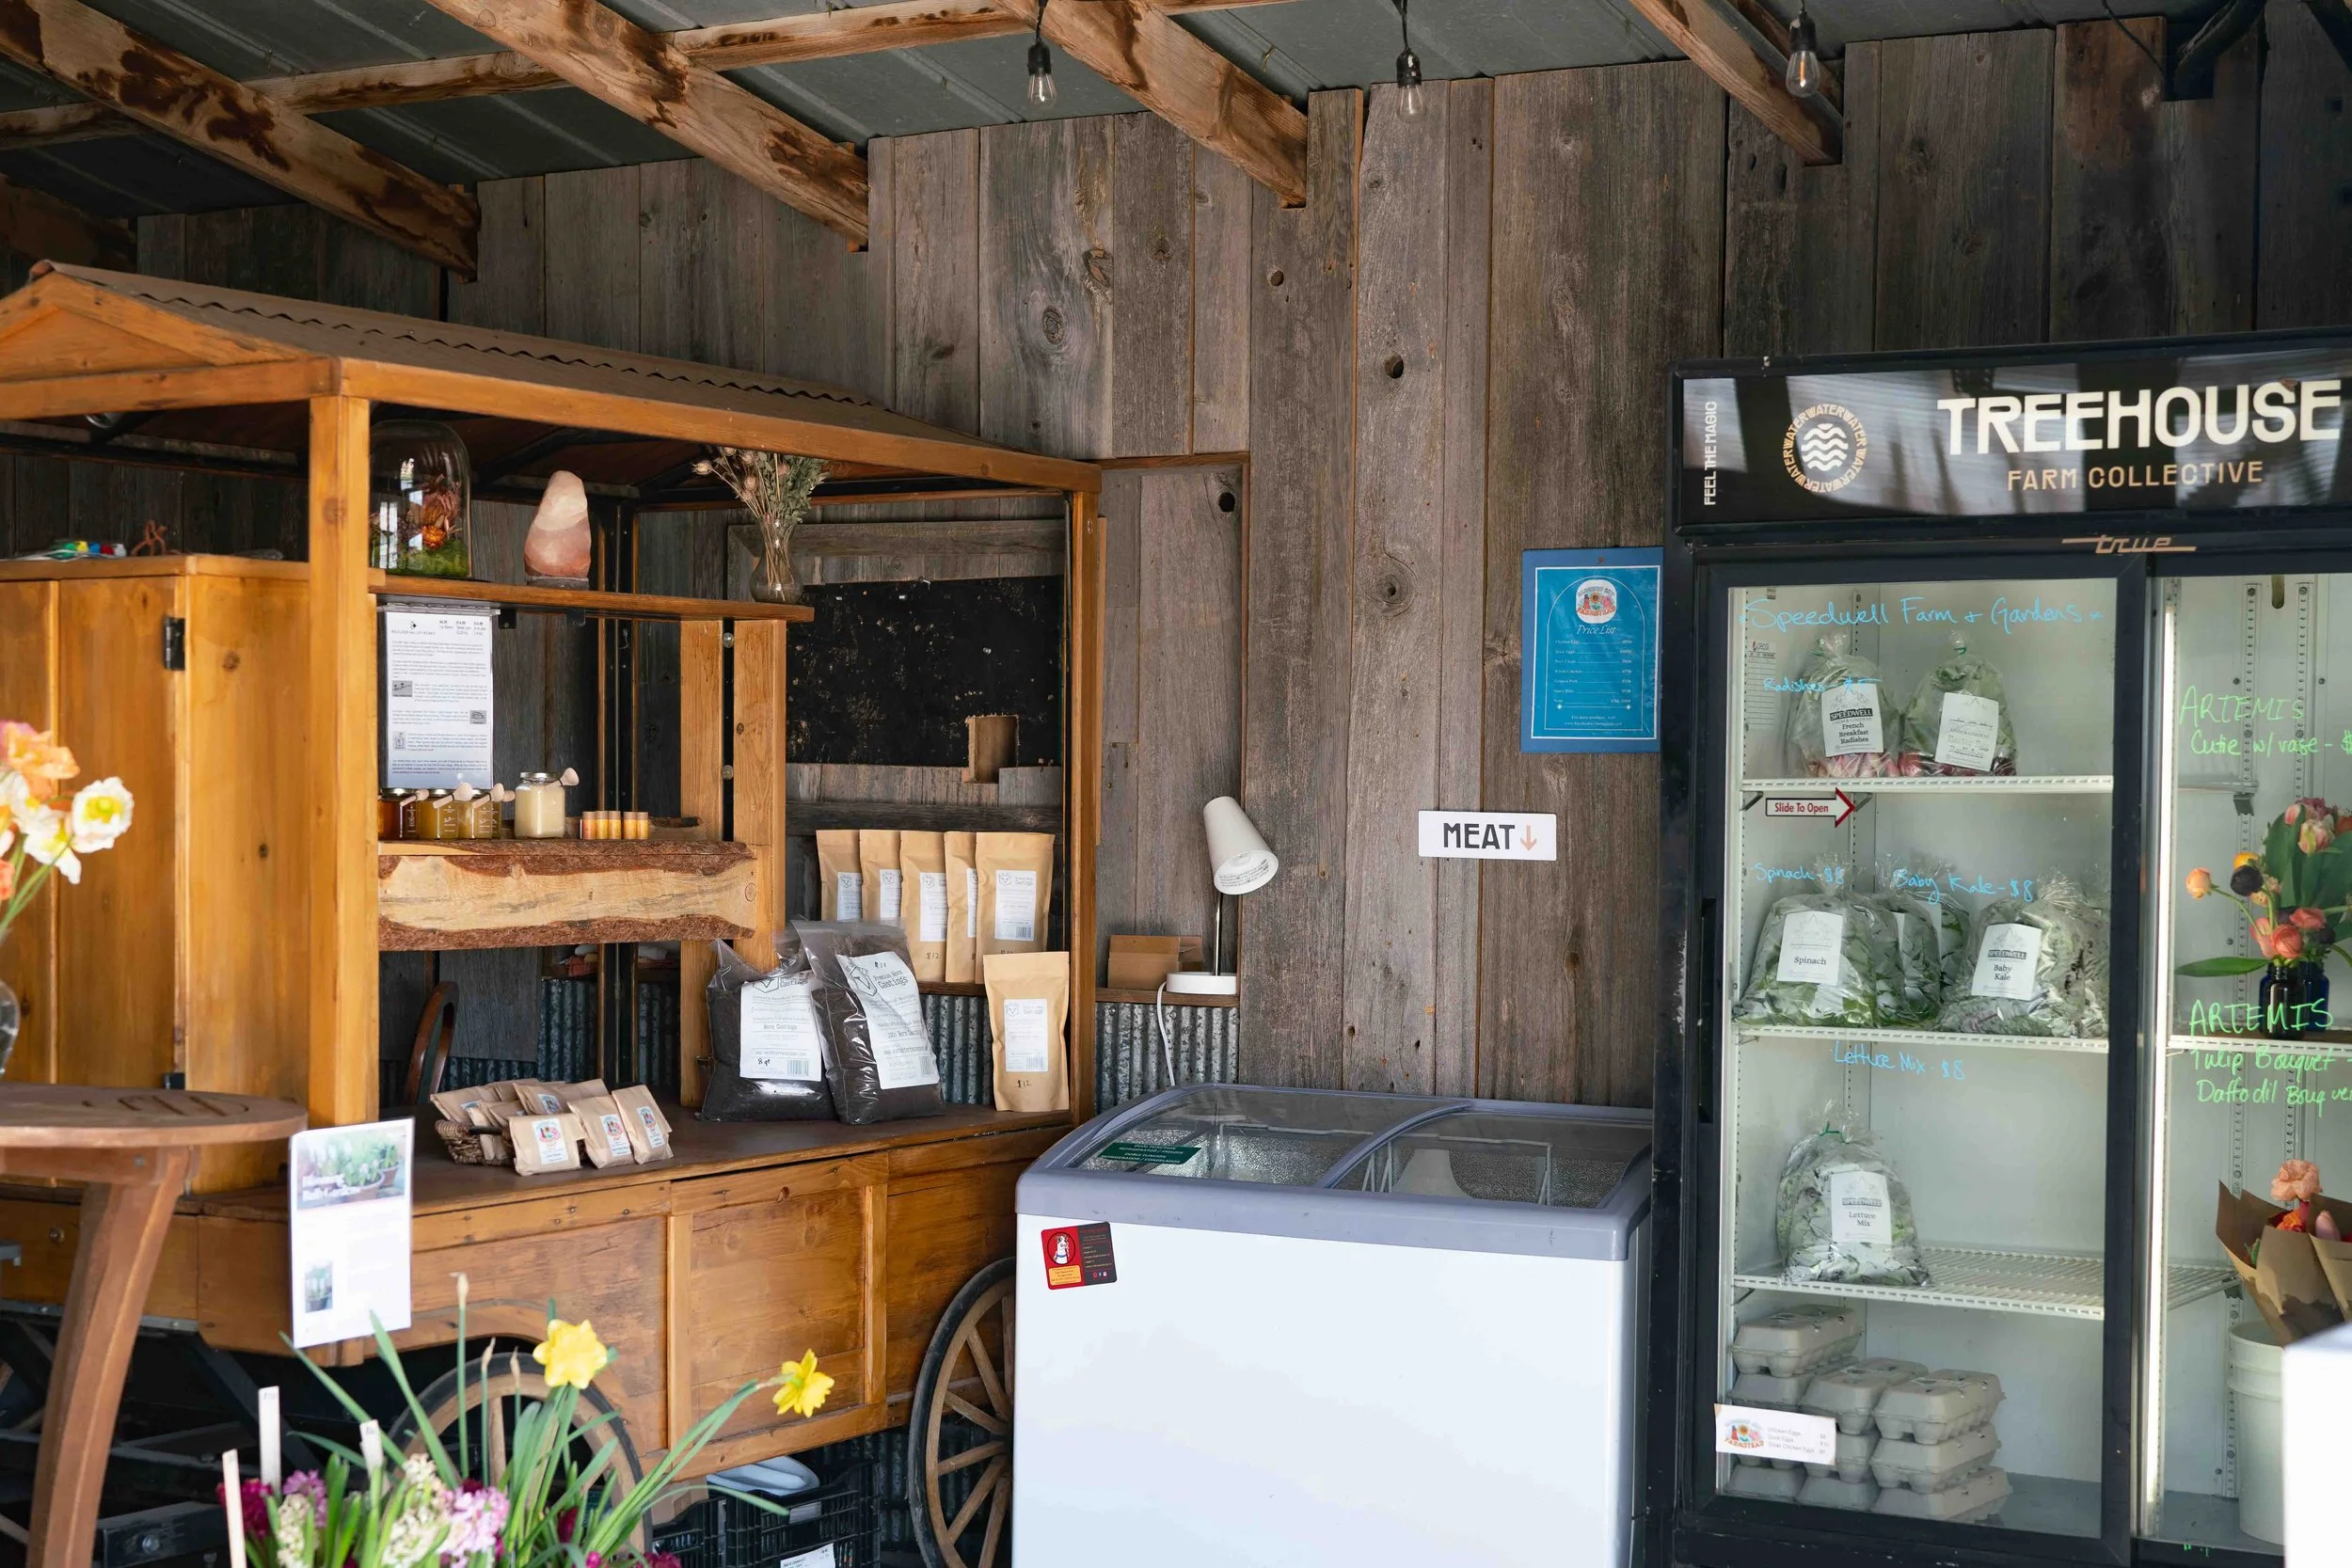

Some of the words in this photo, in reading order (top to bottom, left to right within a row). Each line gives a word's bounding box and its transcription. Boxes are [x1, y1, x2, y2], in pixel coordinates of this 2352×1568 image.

[1936, 379, 2342, 455] TREEHOUSE
[1704, 442, 1717, 470] THE
[1704, 471, 1716, 505] FEEL
[2008, 467, 2076, 491] FARM
[2088, 461, 2263, 488] COLLECTIVE
[1744, 598, 1889, 632] Speedwell
[1899, 595, 1957, 624] Farm
[1990, 595, 2082, 634] Gardens
[1577, 625, 1598, 635] Price
[1599, 625, 1617, 635] List
[1764, 675, 1826, 693] Radishes
[1830, 708, 1873, 721] SPEEDWELL
[2179, 685, 2304, 727] ARTEMIS
[1839, 729, 1868, 737] Breakfast
[1842, 721, 1865, 730] French
[2190, 729, 2241, 755] Cutie
[2279, 736, 2318, 757] vase
[1774, 802, 1794, 813] Slide
[1796, 802, 1804, 813] To
[1807, 802, 1829, 815] Open
[1443, 822, 1516, 849] MEAT
[1754, 863, 1815, 884] Spinach
[1892, 868, 1940, 904] Baby
[1947, 871, 1996, 894] Kale
[1794, 956, 1826, 965] Spinach
[1994, 964, 2012, 974] Baby
[878, 976, 909, 990] Castings
[1994, 973, 2010, 981] Kale
[2189, 998, 2334, 1037] ARTEMIS
[1835, 1040, 1896, 1069] Lettuce
[1899, 1052, 1927, 1074] Mix
[2190, 1046, 2244, 1075] Tulip
[2255, 1045, 2335, 1083] Bouquet
[2196, 1078, 2278, 1103] Daffodil
[1849, 1212, 1877, 1220] Lettuce
